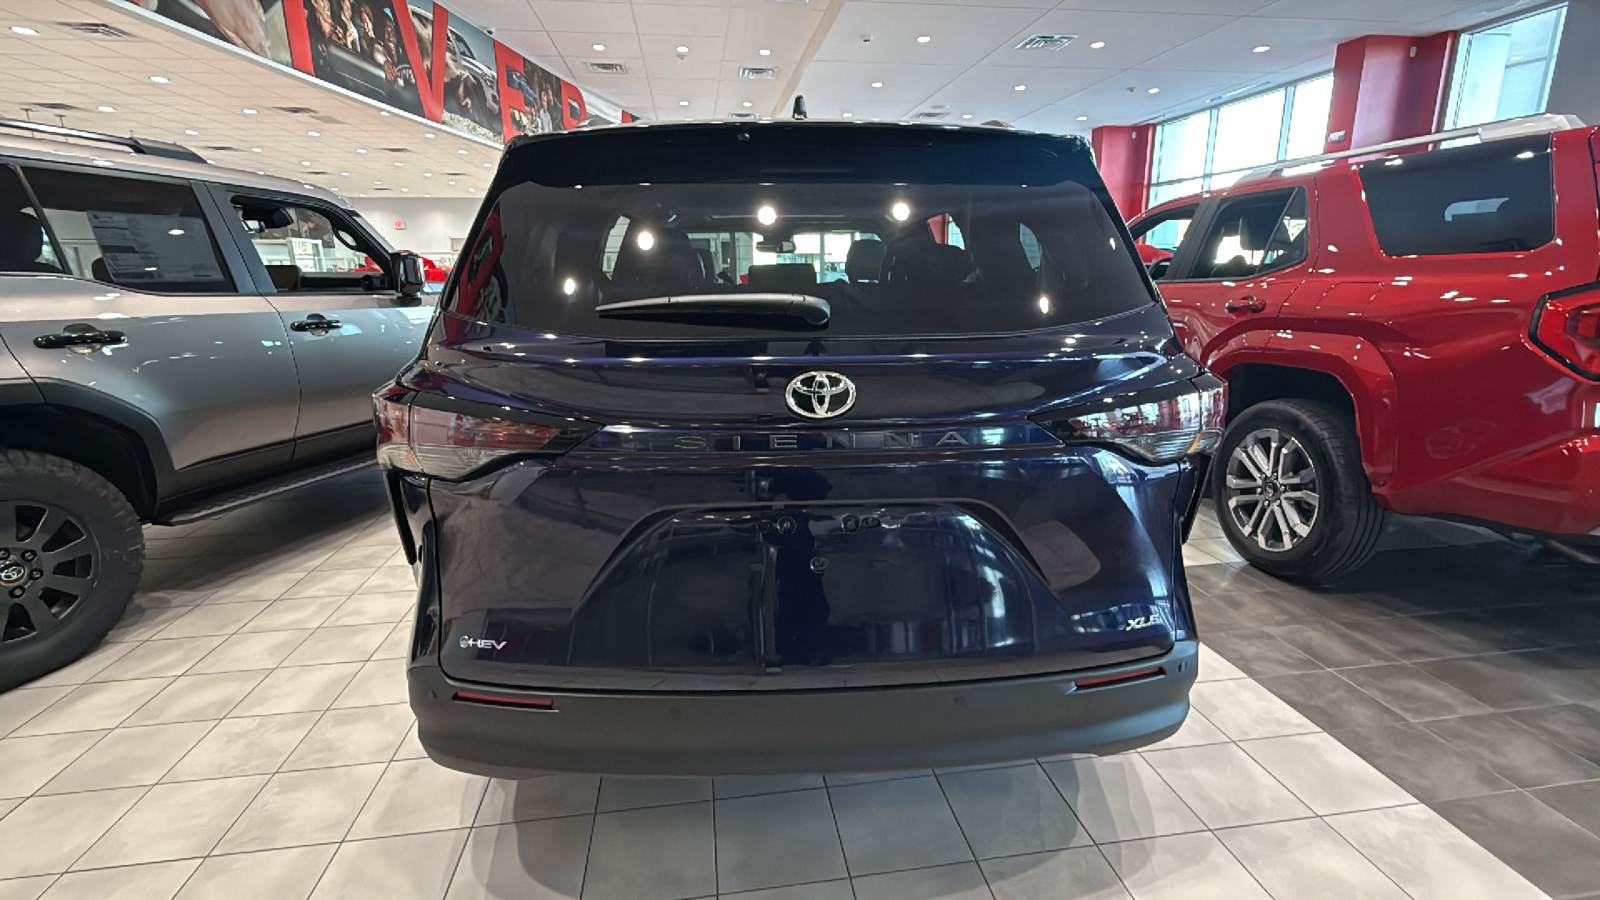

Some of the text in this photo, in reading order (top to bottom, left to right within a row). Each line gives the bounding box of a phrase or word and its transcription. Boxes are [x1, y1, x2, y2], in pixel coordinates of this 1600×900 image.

[675, 431, 968, 451] SIENNA
[1126, 613, 1159, 631] XLE
[470, 638, 507, 650] HEV
